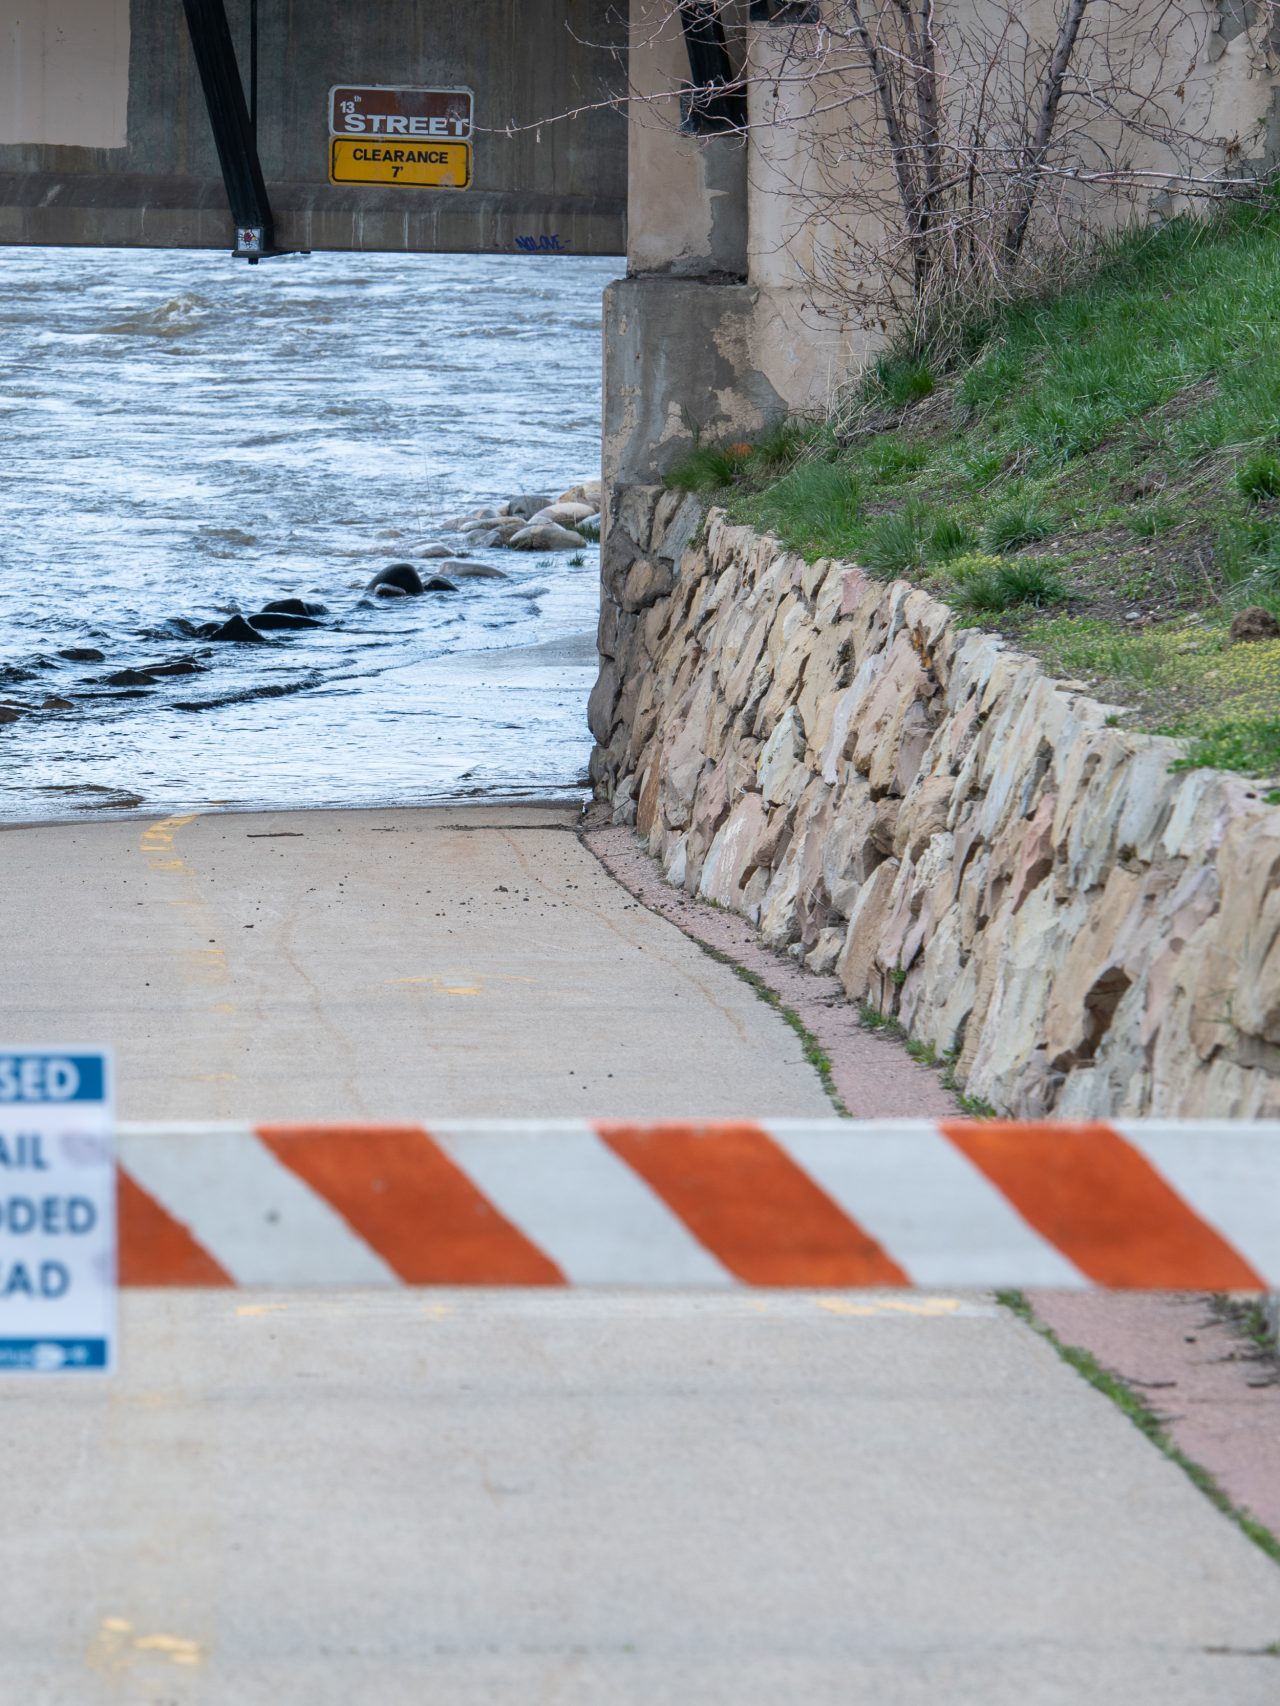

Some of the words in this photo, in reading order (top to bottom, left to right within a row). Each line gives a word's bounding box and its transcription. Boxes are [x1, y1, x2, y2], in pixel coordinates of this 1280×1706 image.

[339, 95, 362, 114] 13th
[344, 113, 470, 136] STREET
[352, 148, 449, 164] CLEARANCE
